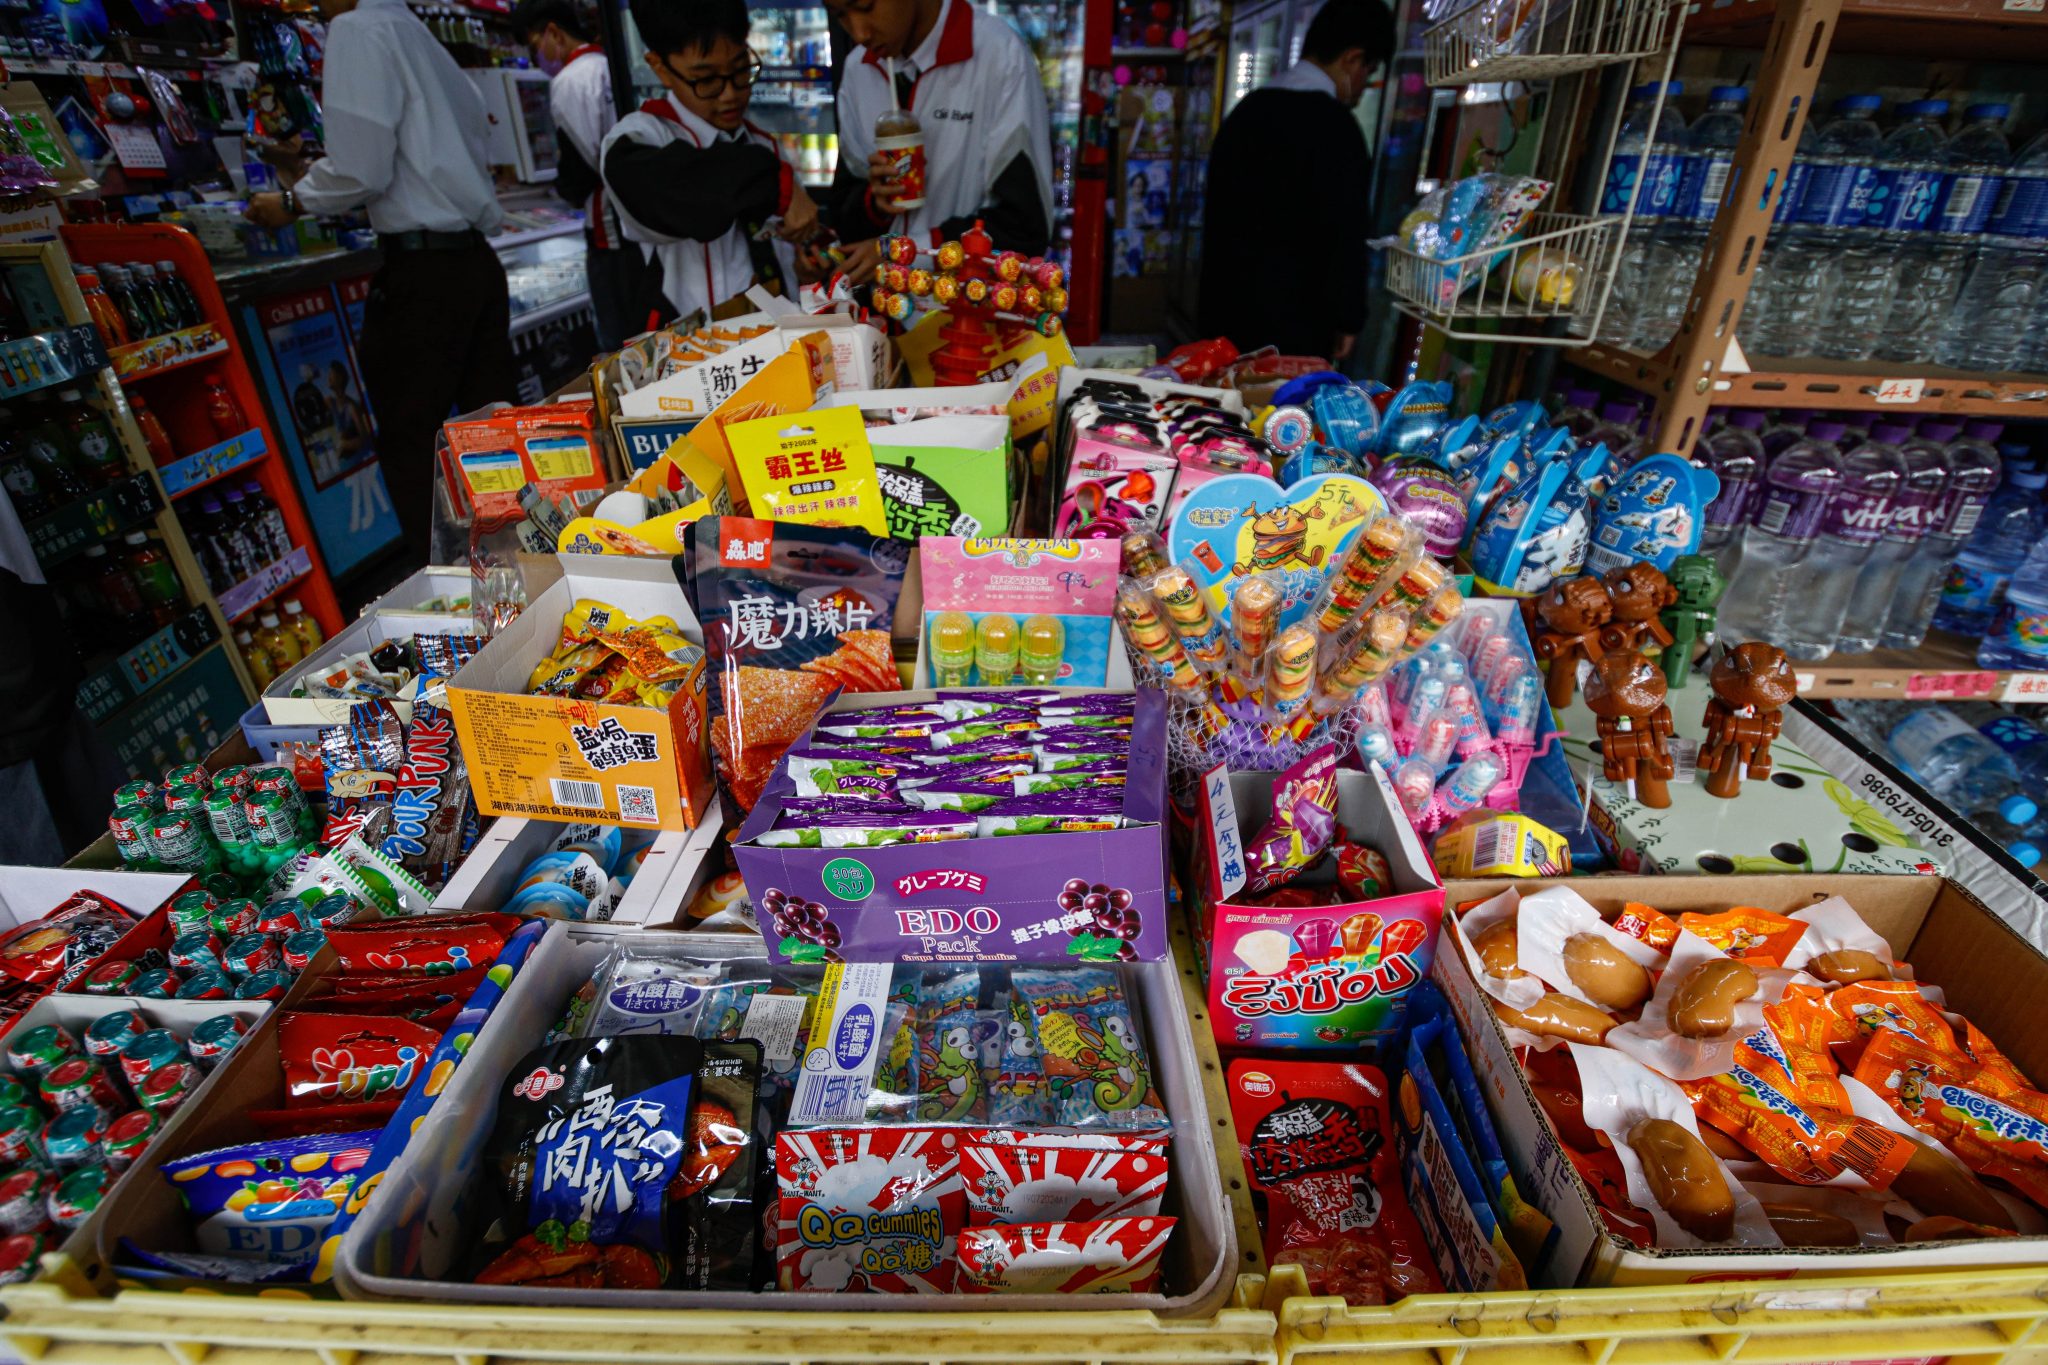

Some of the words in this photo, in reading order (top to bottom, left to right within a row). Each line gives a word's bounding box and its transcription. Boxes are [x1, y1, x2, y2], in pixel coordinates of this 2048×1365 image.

[764, 447, 847, 480] 霸王丝
[773, 503, 820, 518] 辣得出汗
[725, 538, 765, 561] 森吧
[728, 594, 873, 651] 魔力辣片
[399, 719, 453, 788] PUNK
[491, 801, 621, 820] 湖南湖湘贡食品有限公司
[1860, 772, 1955, 848] 3105479386
[832, 867, 865, 880] 30包
[898, 870, 982, 894] グレープグミ
[895, 906, 1001, 936] EDO
[1010, 909, 1095, 945] 提子橡皮糖
[902, 953, 933, 961] Grape
[922, 936, 981, 953] Pack
[626, 983, 687, 999] 乳酸菌
[850, 1013, 871, 1057] 乳酸菌
[312, 1046, 418, 1101] Yupi
[801, 1206, 867, 1245] QQ
[868, 1208, 942, 1244] Gummies
[862, 1241, 934, 1272] QQ糖
